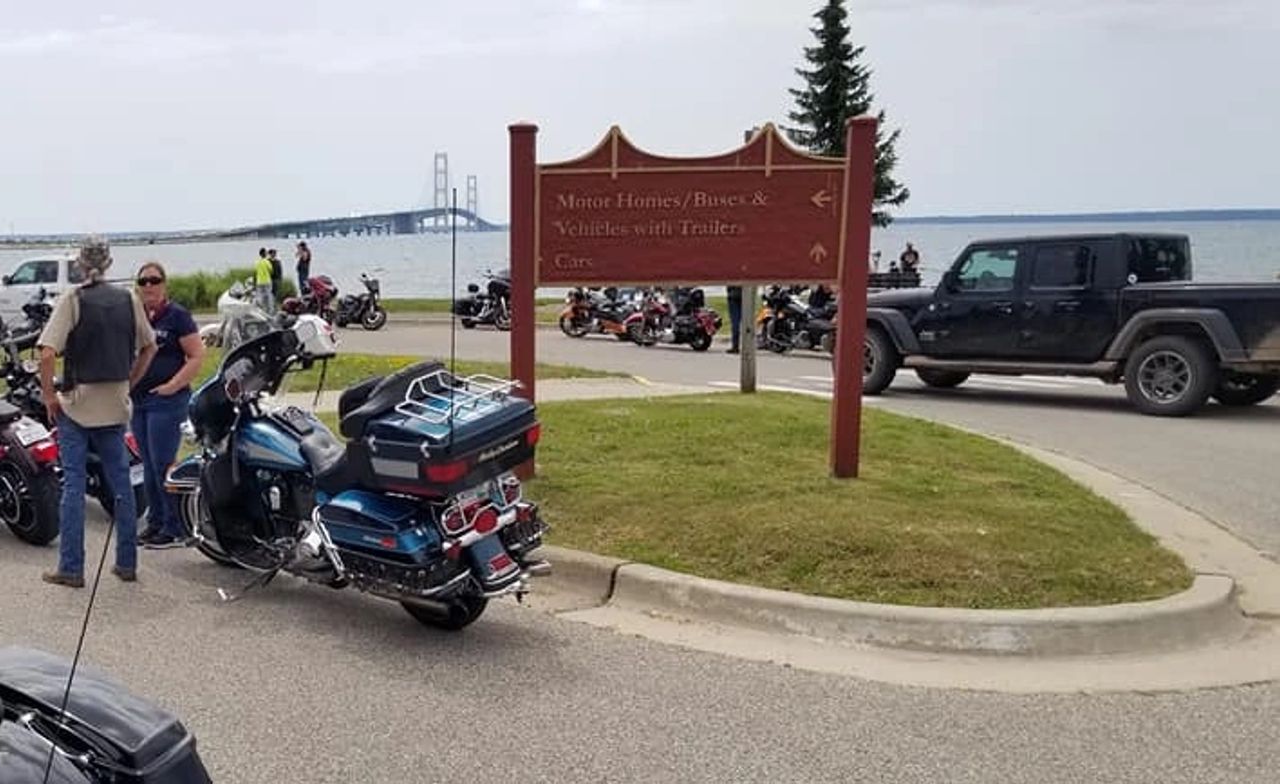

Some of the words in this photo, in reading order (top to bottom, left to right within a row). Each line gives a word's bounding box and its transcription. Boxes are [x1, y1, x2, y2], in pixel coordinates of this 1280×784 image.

[558, 194, 611, 209] Motor
[617, 191, 746, 208] Homes/Buses
[752, 190, 767, 206] &
[552, 220, 628, 236] Vehicles
[634, 220, 673, 236] with
[678, 219, 745, 236] Trailers
[554, 253, 593, 269] Cars
